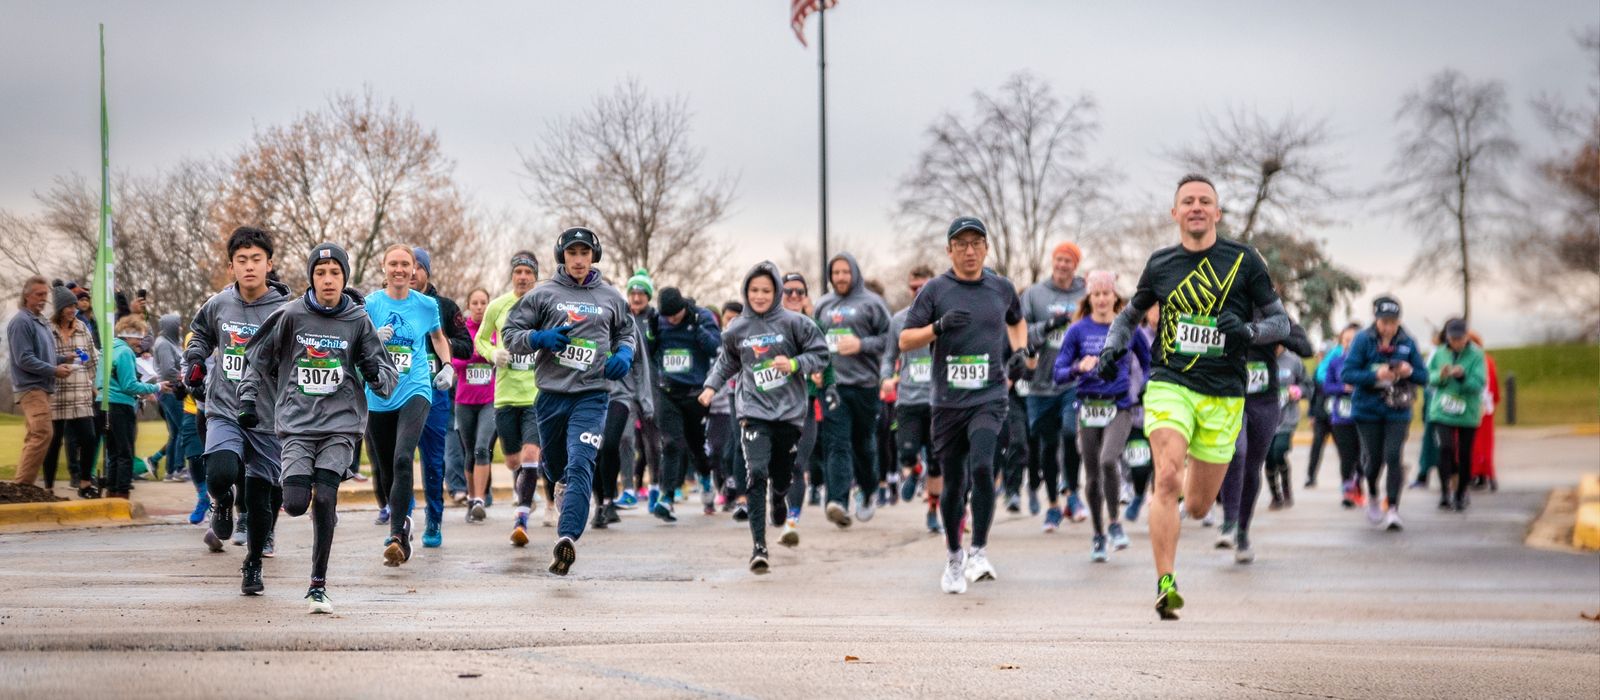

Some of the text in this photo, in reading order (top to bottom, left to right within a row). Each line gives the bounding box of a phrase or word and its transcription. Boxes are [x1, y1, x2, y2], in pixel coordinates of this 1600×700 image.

[1180, 324, 1221, 346] 3088
[665, 355, 687, 366] 3007
[301, 368, 340, 385] 3074
[467, 369, 491, 379] 3009
[951, 365, 985, 380] 2993
[1085, 406, 1113, 418] 3042
